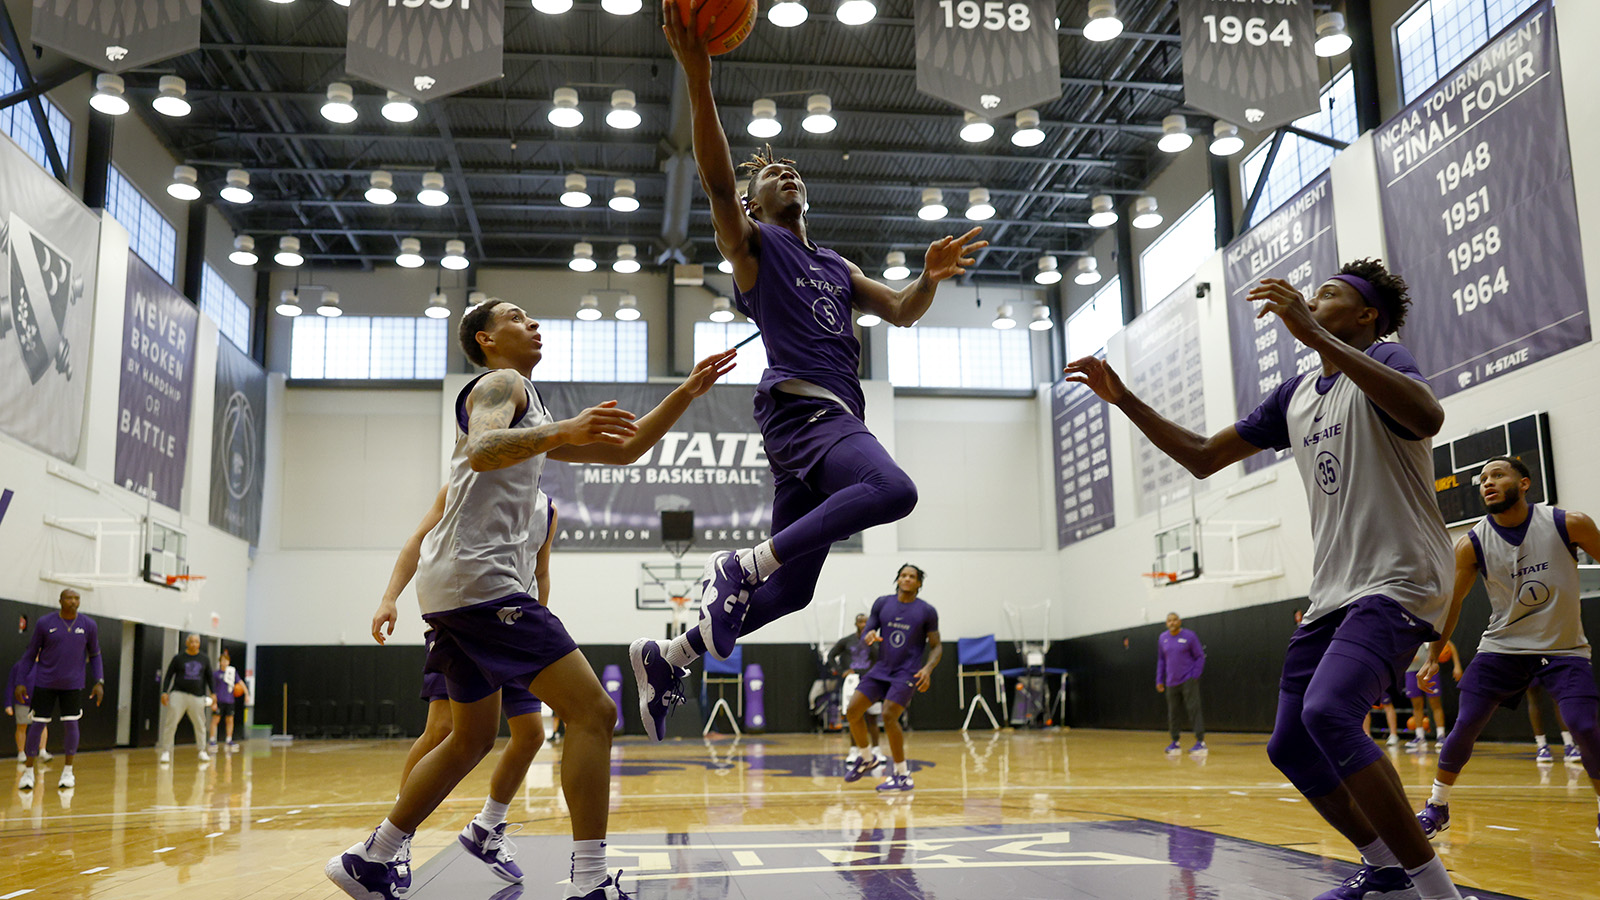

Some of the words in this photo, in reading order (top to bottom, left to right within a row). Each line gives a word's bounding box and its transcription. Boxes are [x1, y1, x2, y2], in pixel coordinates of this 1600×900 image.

[938, 0, 1032, 32] 1958
[1202, 15, 1293, 47] 1964
[1379, 110, 1422, 151] NCAA
[1423, 12, 1543, 117] TOURNAMENT
[1392, 112, 1457, 174] FINAL
[1461, 51, 1535, 124] FOUR
[1436, 141, 1491, 196] 1948
[1227, 235, 1256, 268] NCAA
[1253, 180, 1327, 246] TOURNAMENT
[1441, 185, 1490, 236] 1951
[1250, 229, 1291, 276] ELITE
[1292, 220, 1304, 245] 8
[1447, 225, 1501, 276] 1958
[796, 277, 843, 296] K-STATE
[1288, 260, 1312, 286] 1975
[1452, 265, 1510, 316] 1964
[134, 291, 187, 354] NEVER
[822, 304, 836, 325] 5
[130, 326, 184, 382] BROKEN
[1485, 347, 1529, 377] K-STATE
[127, 358, 140, 375] BY
[142, 367, 181, 402] HARDSHIP
[145, 394, 161, 416] OR
[120, 408, 176, 459] BATTLE
[1304, 423, 1342, 448] K-STATE
[583, 468, 642, 484] MEN'S
[645, 468, 761, 485] BASKETBALL
[1319, 459, 1336, 485] 35
[560, 529, 650, 540] ADITION
[705, 530, 769, 540] EXCEL
[1529, 586, 1538, 601] 1
